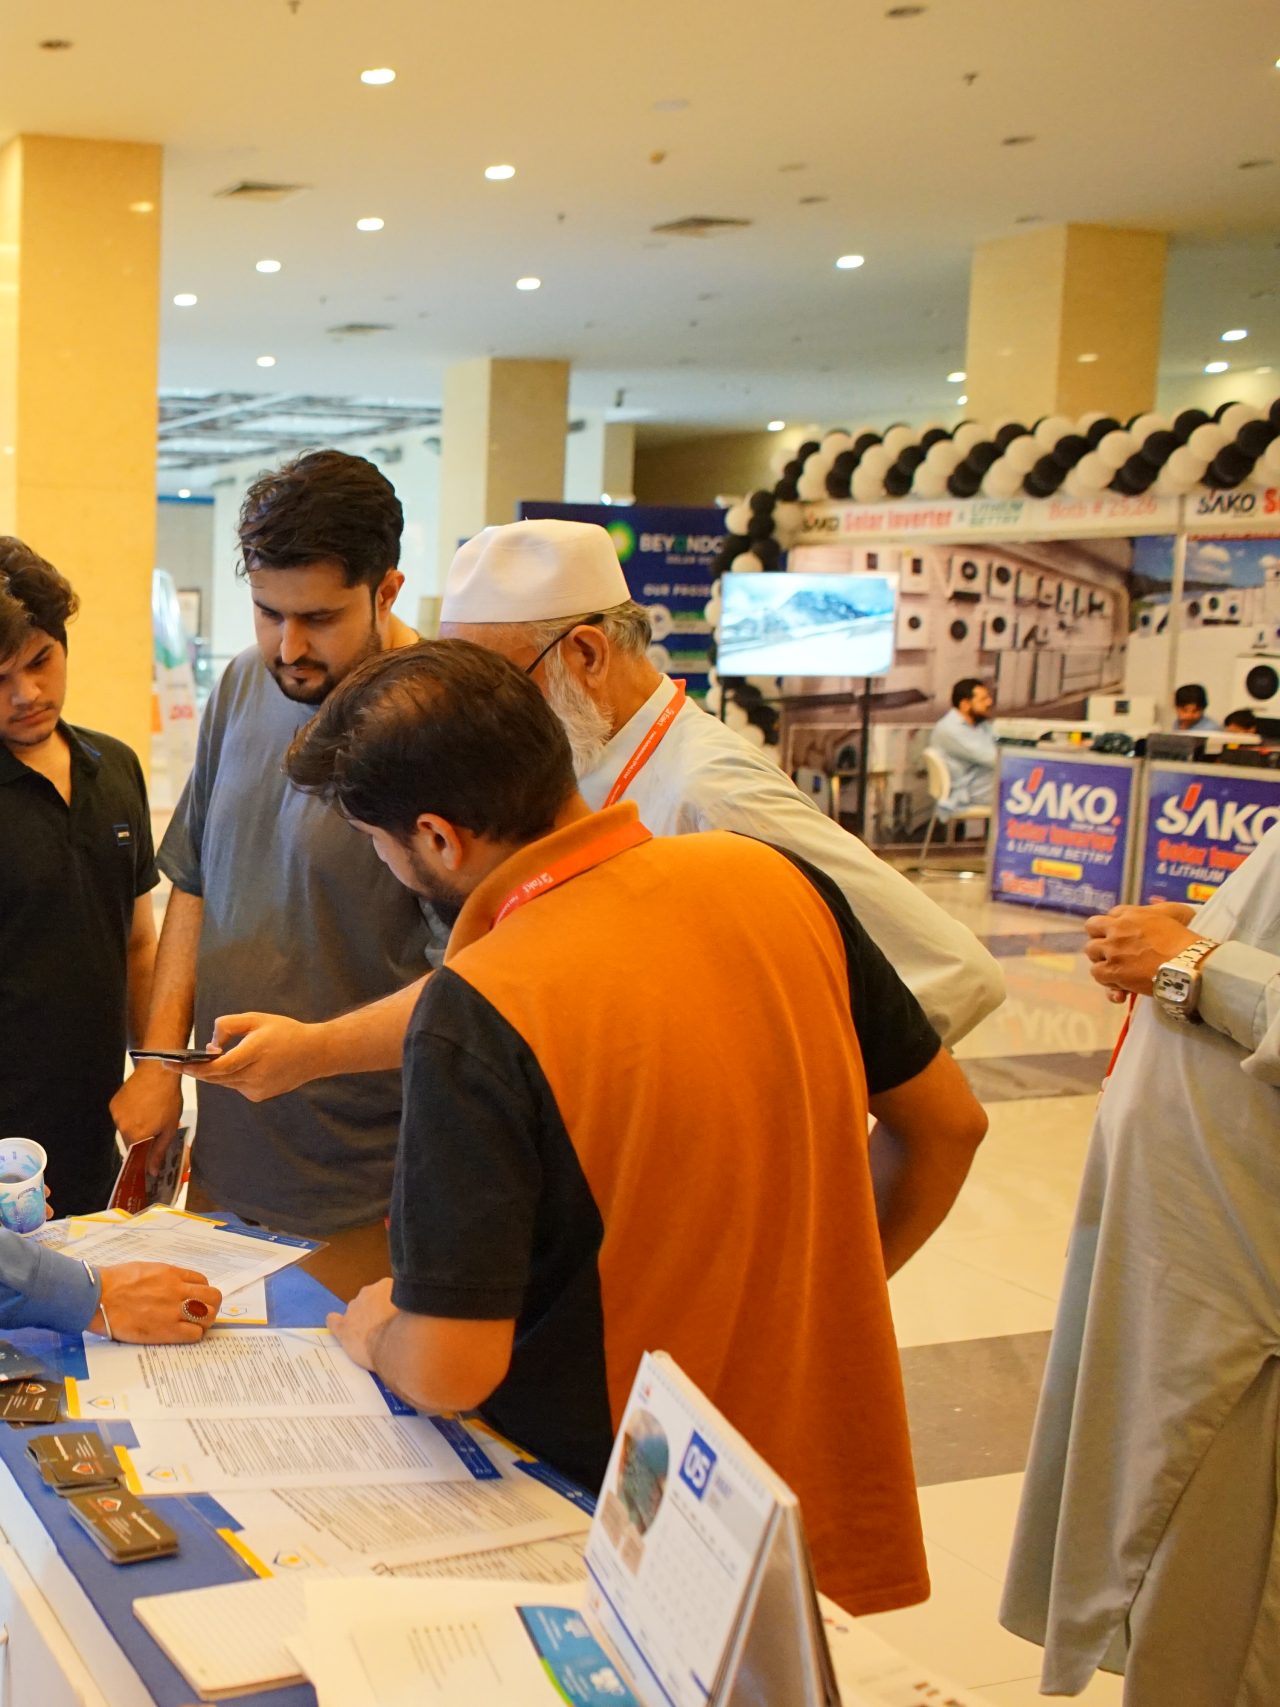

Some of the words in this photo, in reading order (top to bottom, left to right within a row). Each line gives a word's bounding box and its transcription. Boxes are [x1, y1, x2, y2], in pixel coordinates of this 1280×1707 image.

[1197, 489, 1256, 515] SAKO
[887, 507, 954, 530] Inverter
[1006, 767, 1119, 825] SAKO
